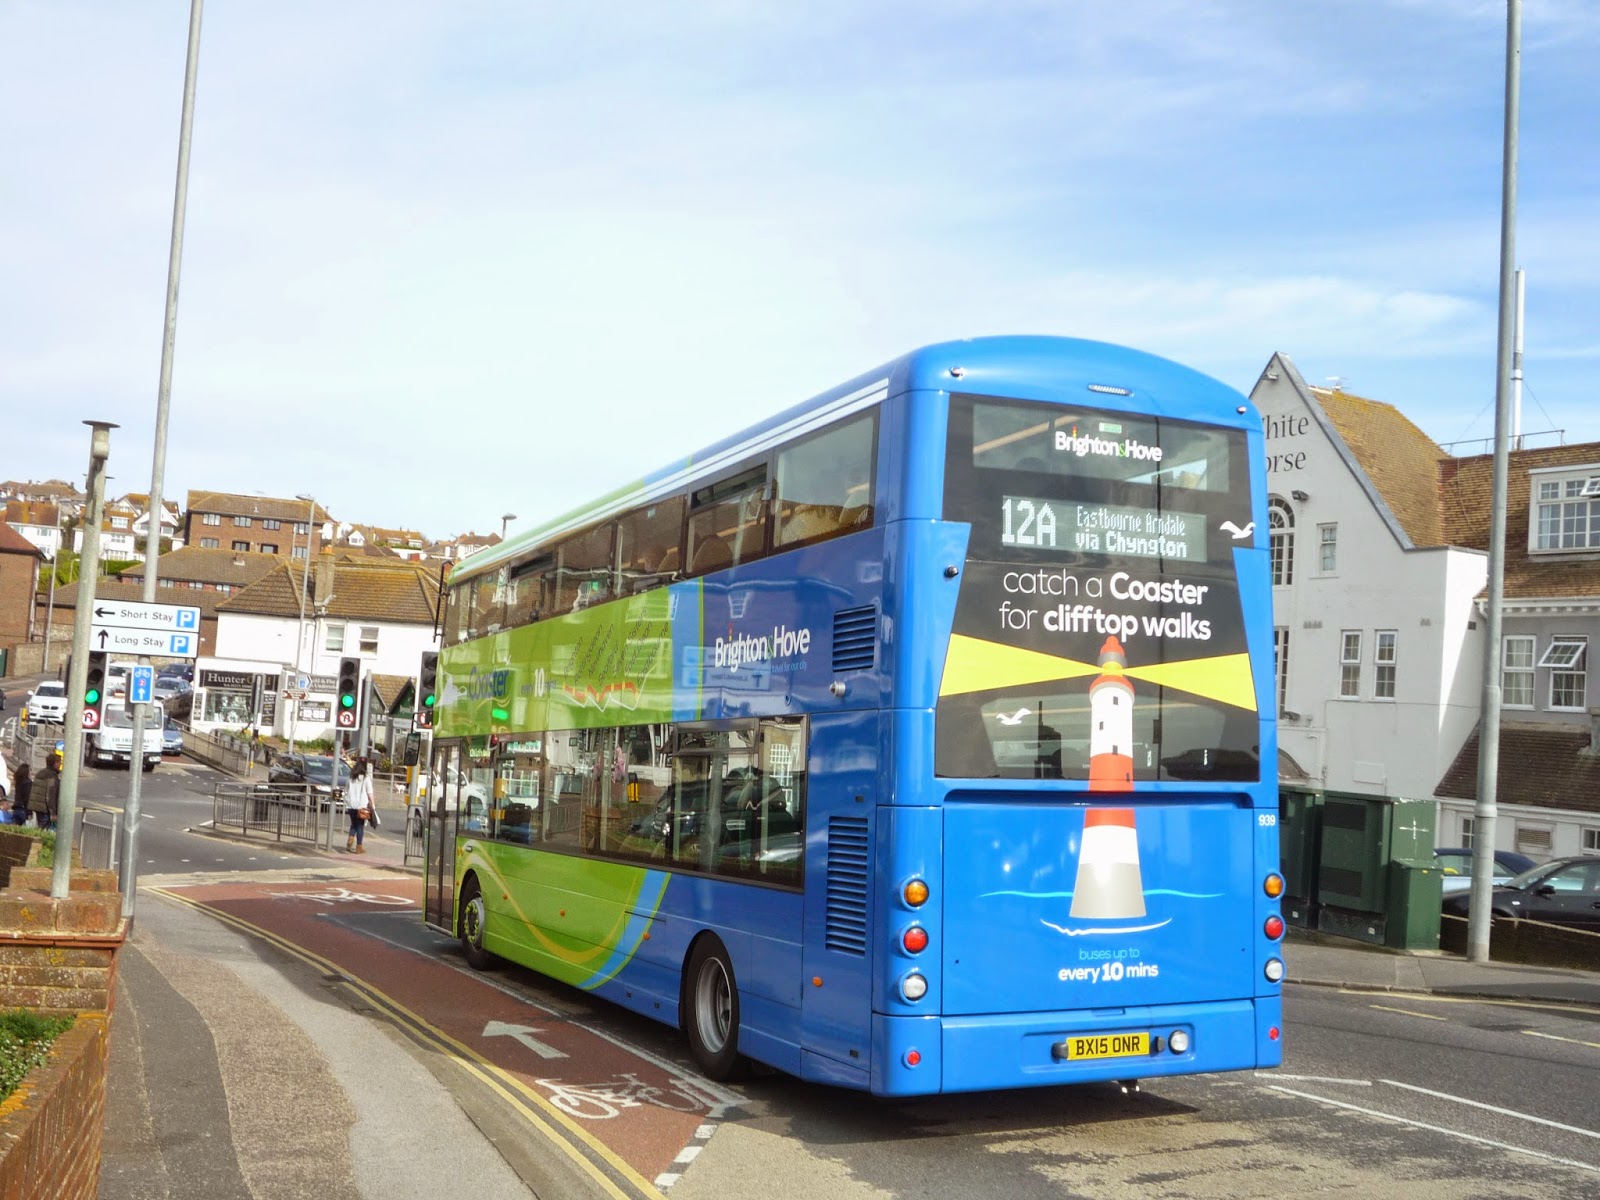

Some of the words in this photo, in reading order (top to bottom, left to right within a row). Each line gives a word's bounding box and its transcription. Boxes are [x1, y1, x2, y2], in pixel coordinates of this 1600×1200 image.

[1262, 415, 1309, 440] hite
[1265, 451, 1306, 473] orse
[1001, 498, 1057, 547] 12A
[1076, 505, 1142, 532] Eastbourne
[1145, 512, 1186, 536] Arndale
[1075, 528, 1100, 550] via
[1105, 530, 1188, 558] Chyngton
[1002, 568, 1079, 597] catch
[1085, 576, 1102, 598] a
[1109, 571, 1209, 605] Coaster
[120, 609, 148, 620] Short
[152, 611, 174, 623] Stay
[179, 611, 193, 628] P
[999, 601, 1038, 630] for
[1043, 604, 1139, 642] clifftop
[1141, 610, 1212, 640] walks
[114, 635, 139, 646] Long
[143, 637, 165, 648] Stay
[173, 636, 187, 653] P
[208, 672, 246, 685] Hunter
[534, 667, 545, 698] 10
[1258, 814, 1275, 827] 939
[1079, 948, 1111, 960] buses
[1113, 949, 1128, 961] up
[1129, 947, 1140, 958] to
[1058, 967, 1101, 984] every
[1101, 962, 1124, 981] 10
[1126, 962, 1159, 978] mins
[1075, 1036, 1109, 1057] BX15
[1111, 1035, 1141, 1055] ONR
